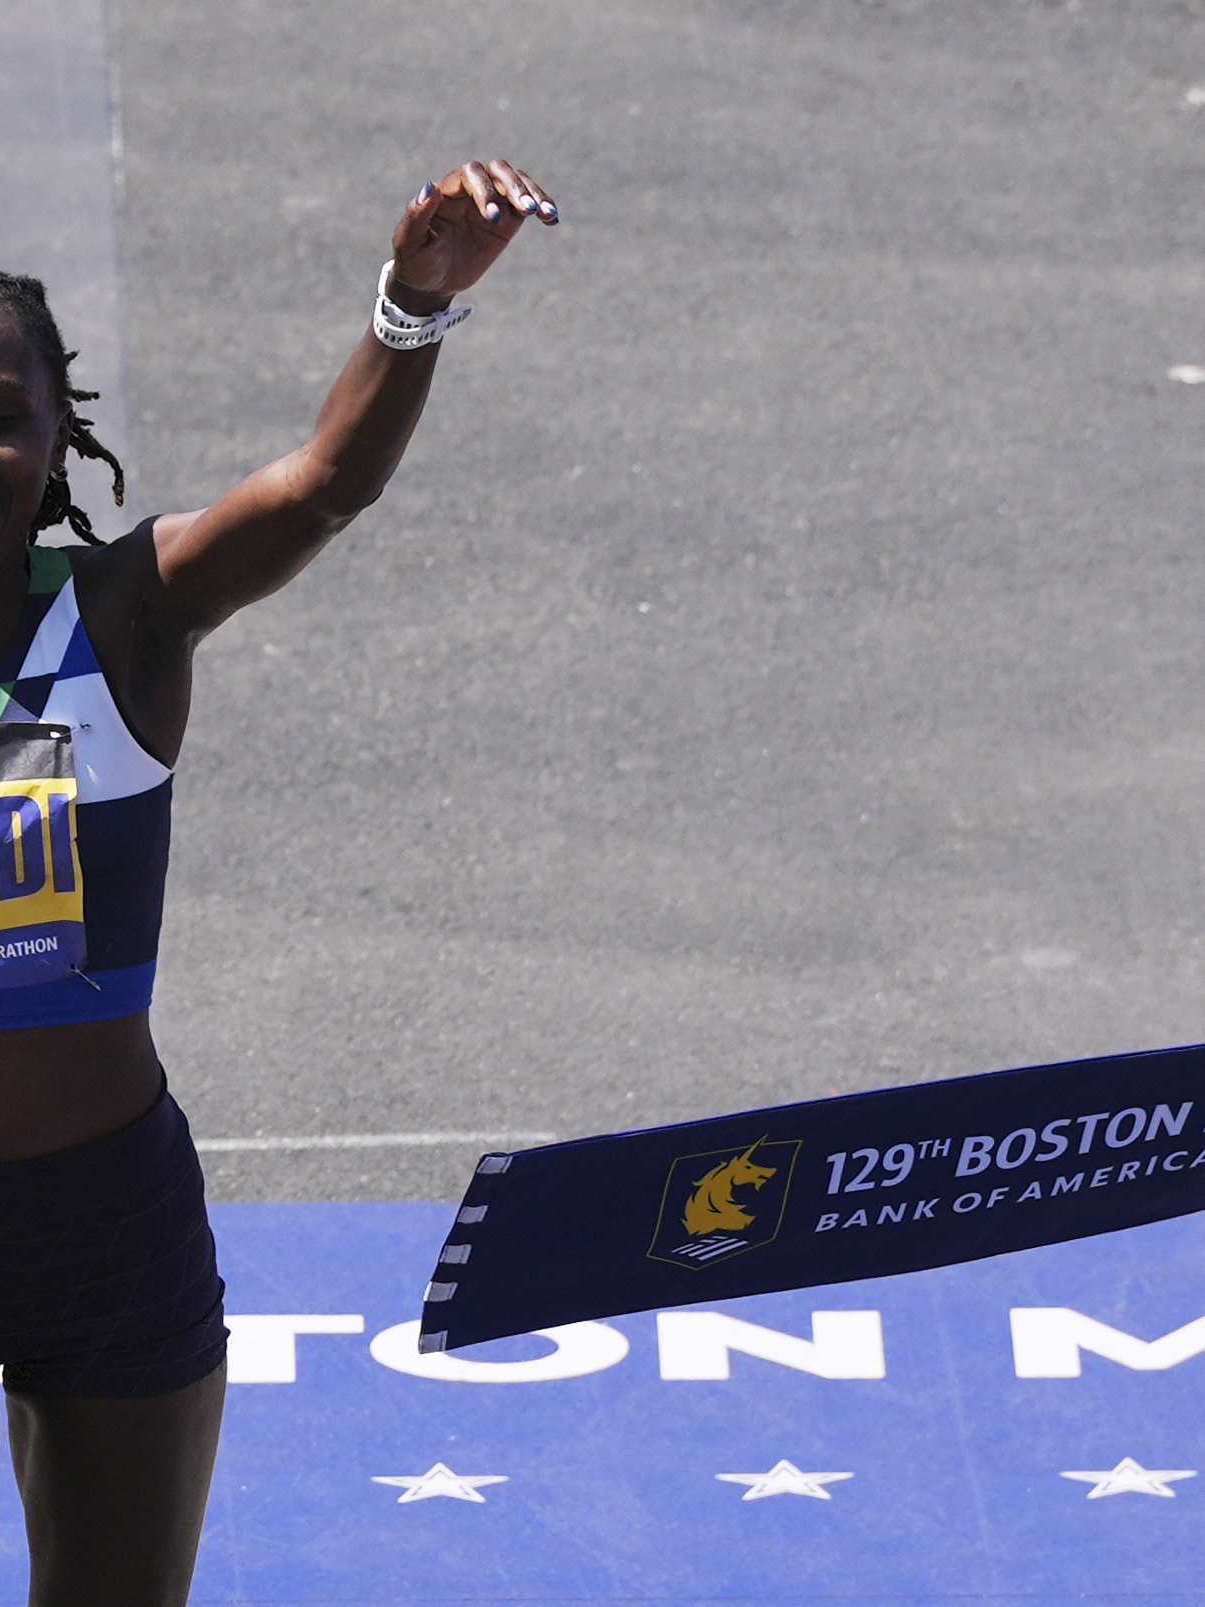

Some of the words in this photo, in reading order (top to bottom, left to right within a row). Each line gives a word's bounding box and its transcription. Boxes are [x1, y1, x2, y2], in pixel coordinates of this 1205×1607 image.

[826, 1138, 952, 1195] 129TH
[955, 1101, 1194, 1177] BOSTON
[814, 1197, 940, 1233] BANK
[952, 1186, 1010, 1213] OF
